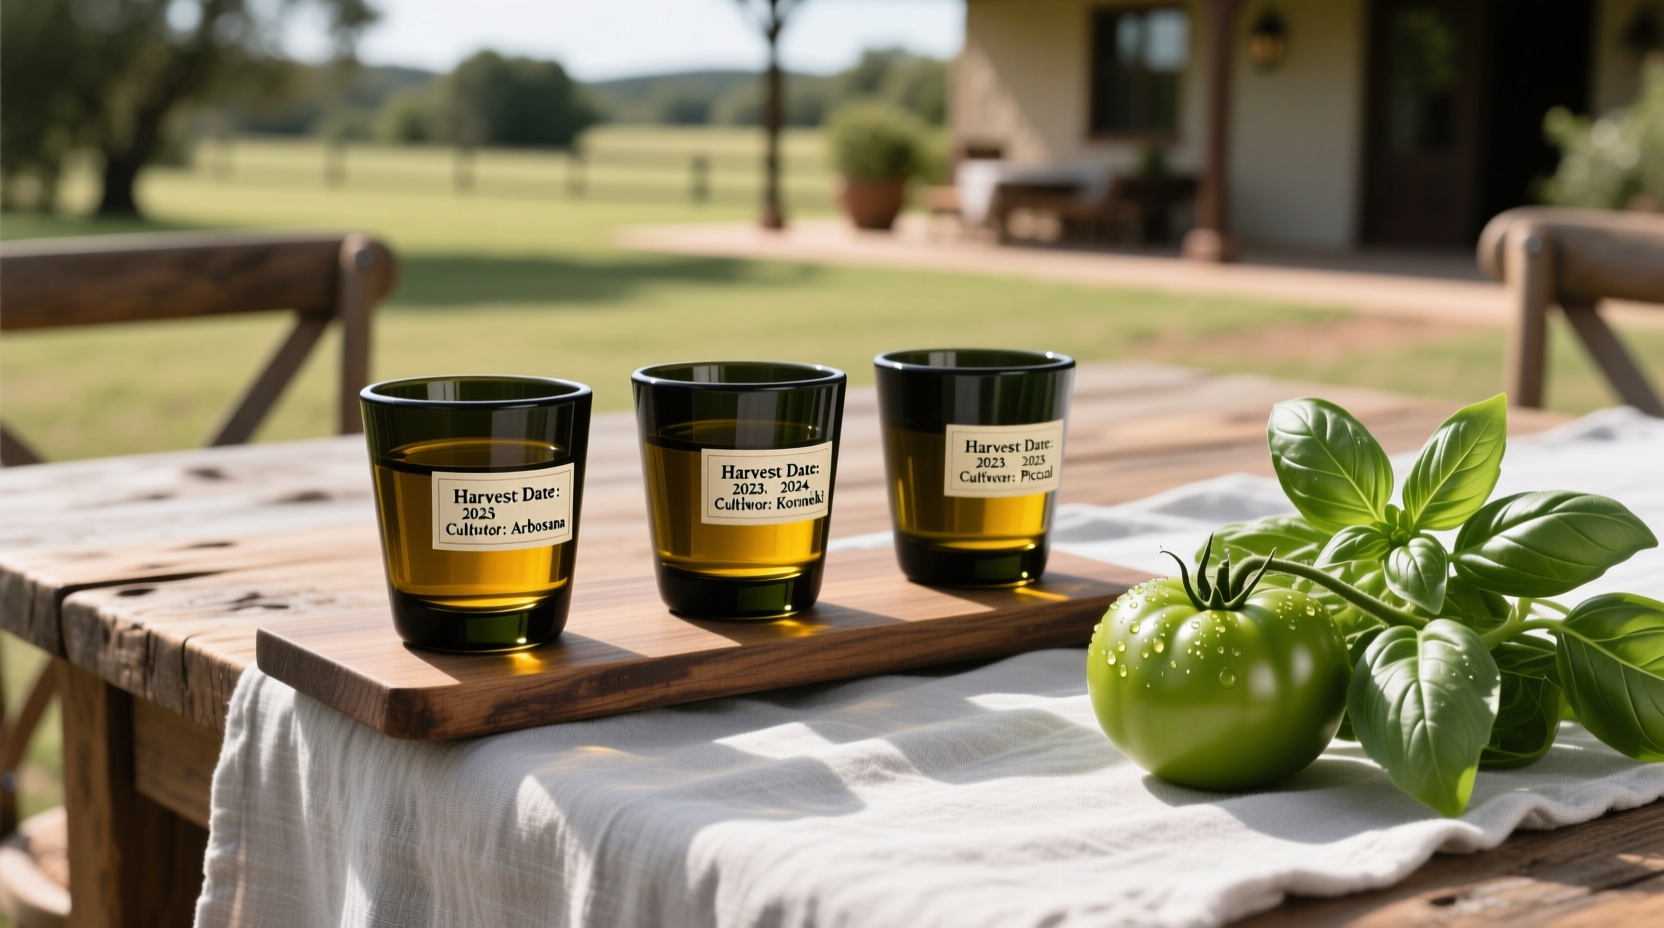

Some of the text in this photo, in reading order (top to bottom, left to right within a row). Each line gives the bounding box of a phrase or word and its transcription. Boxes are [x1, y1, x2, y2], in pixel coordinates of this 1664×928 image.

[964, 439, 1053, 453] Harvest Date:
[721, 463, 820, 479] Harvest Date:
[780, 479, 810, 493] 2024
[453, 487, 560, 504] Harvest Date:
[511, 518, 565, 535] Arbosana
